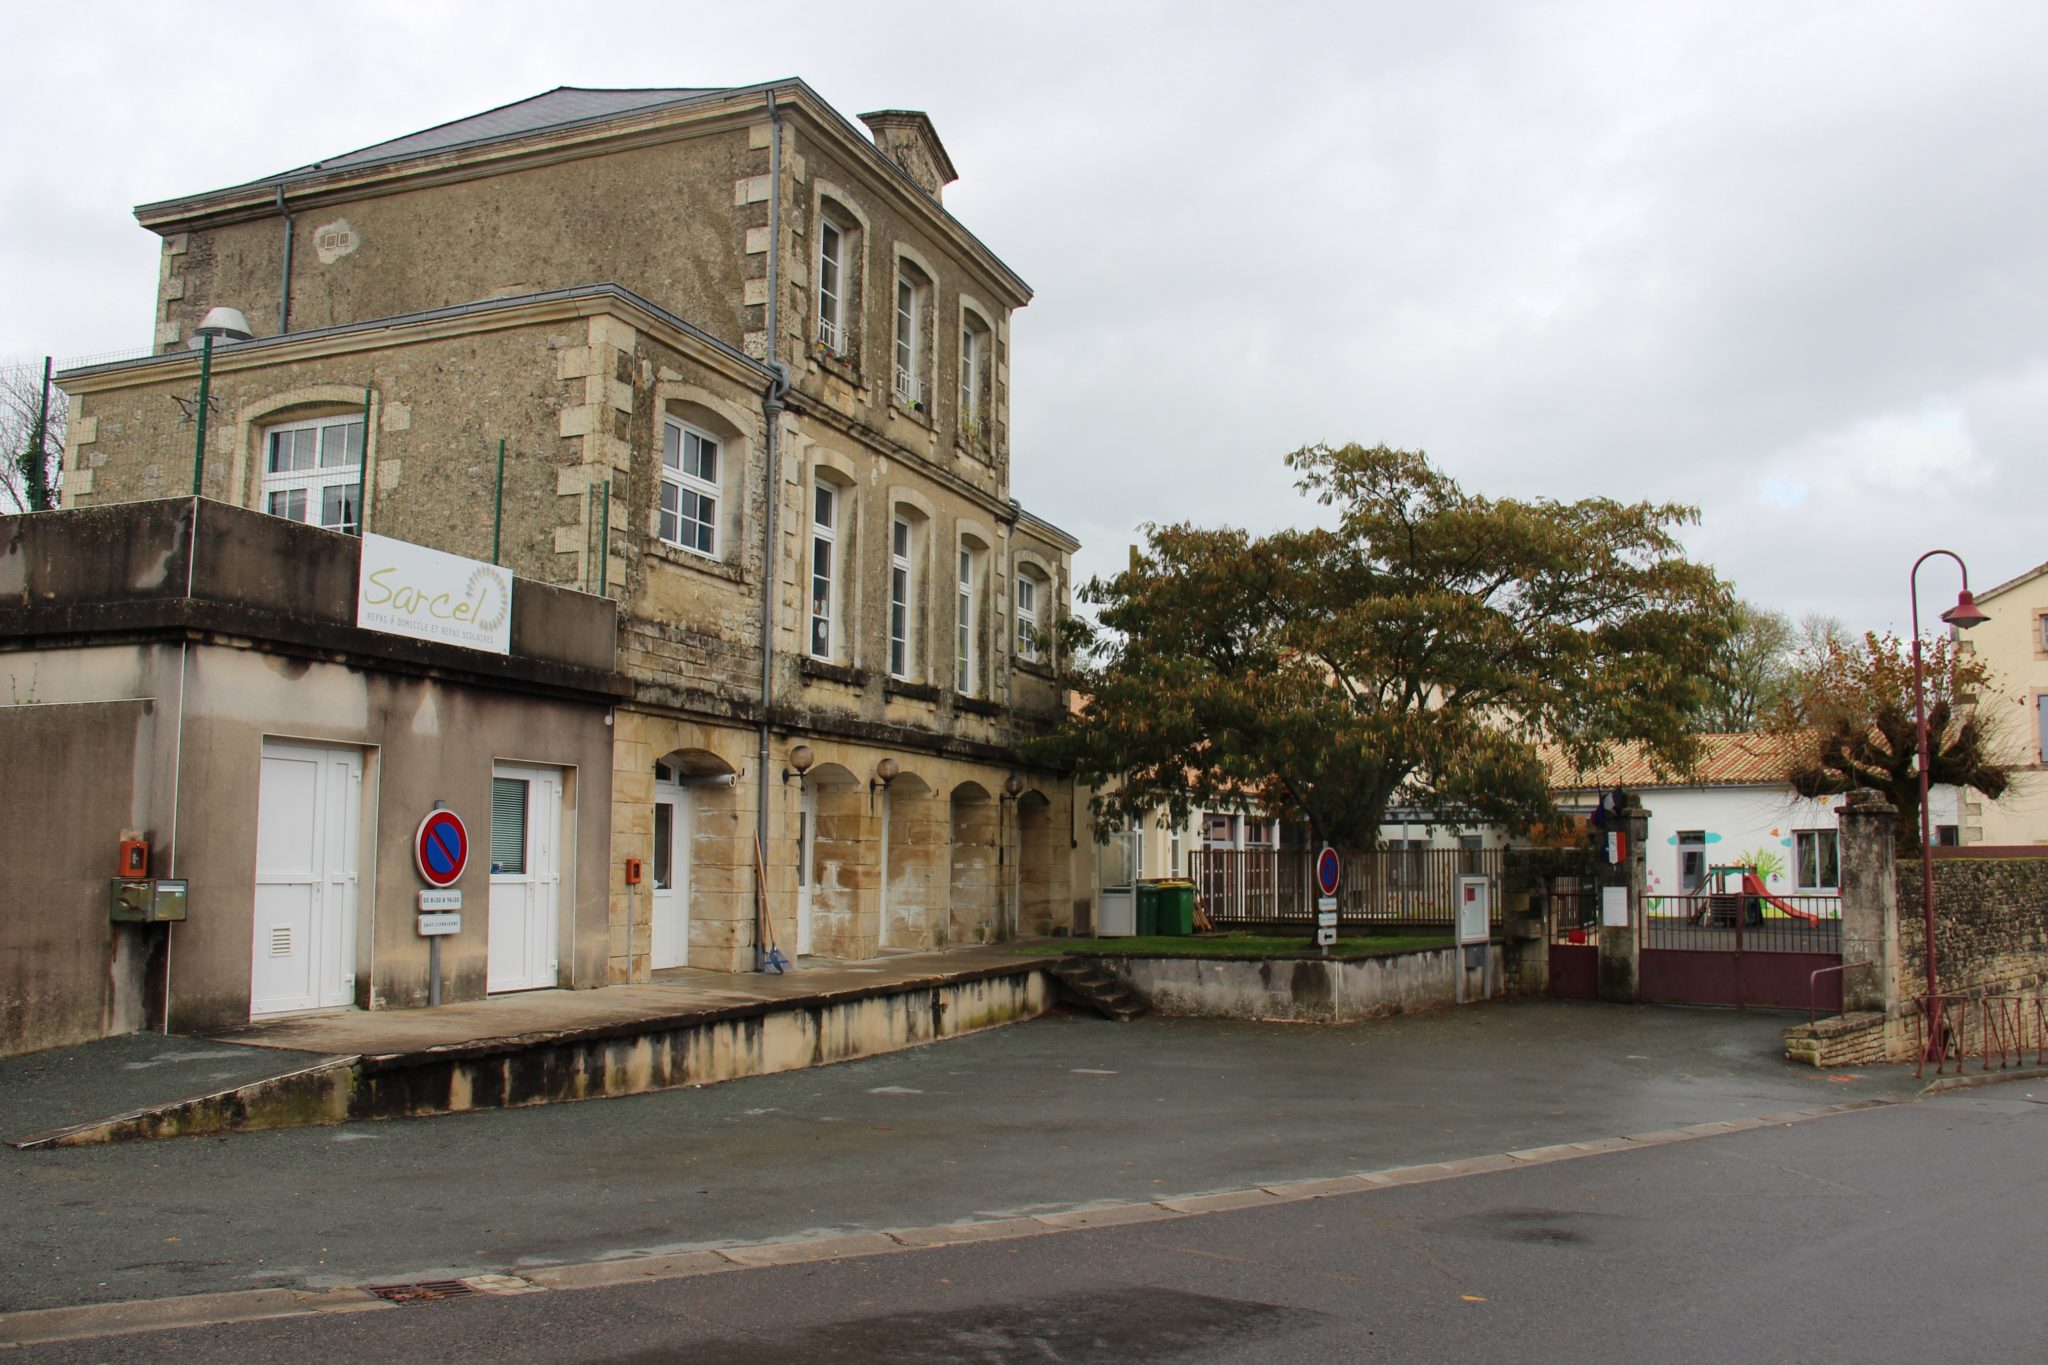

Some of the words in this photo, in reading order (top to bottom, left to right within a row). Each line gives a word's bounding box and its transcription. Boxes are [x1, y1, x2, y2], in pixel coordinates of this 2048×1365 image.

[364, 567, 487, 624] Sarcel
[367, 612, 388, 624] REPAS
[397, 619, 428, 632] DOMICILE
[431, 625, 439, 633] ET
[442, 627, 460, 637] REPAS
[463, 631, 494, 644] SCOLAIRES
